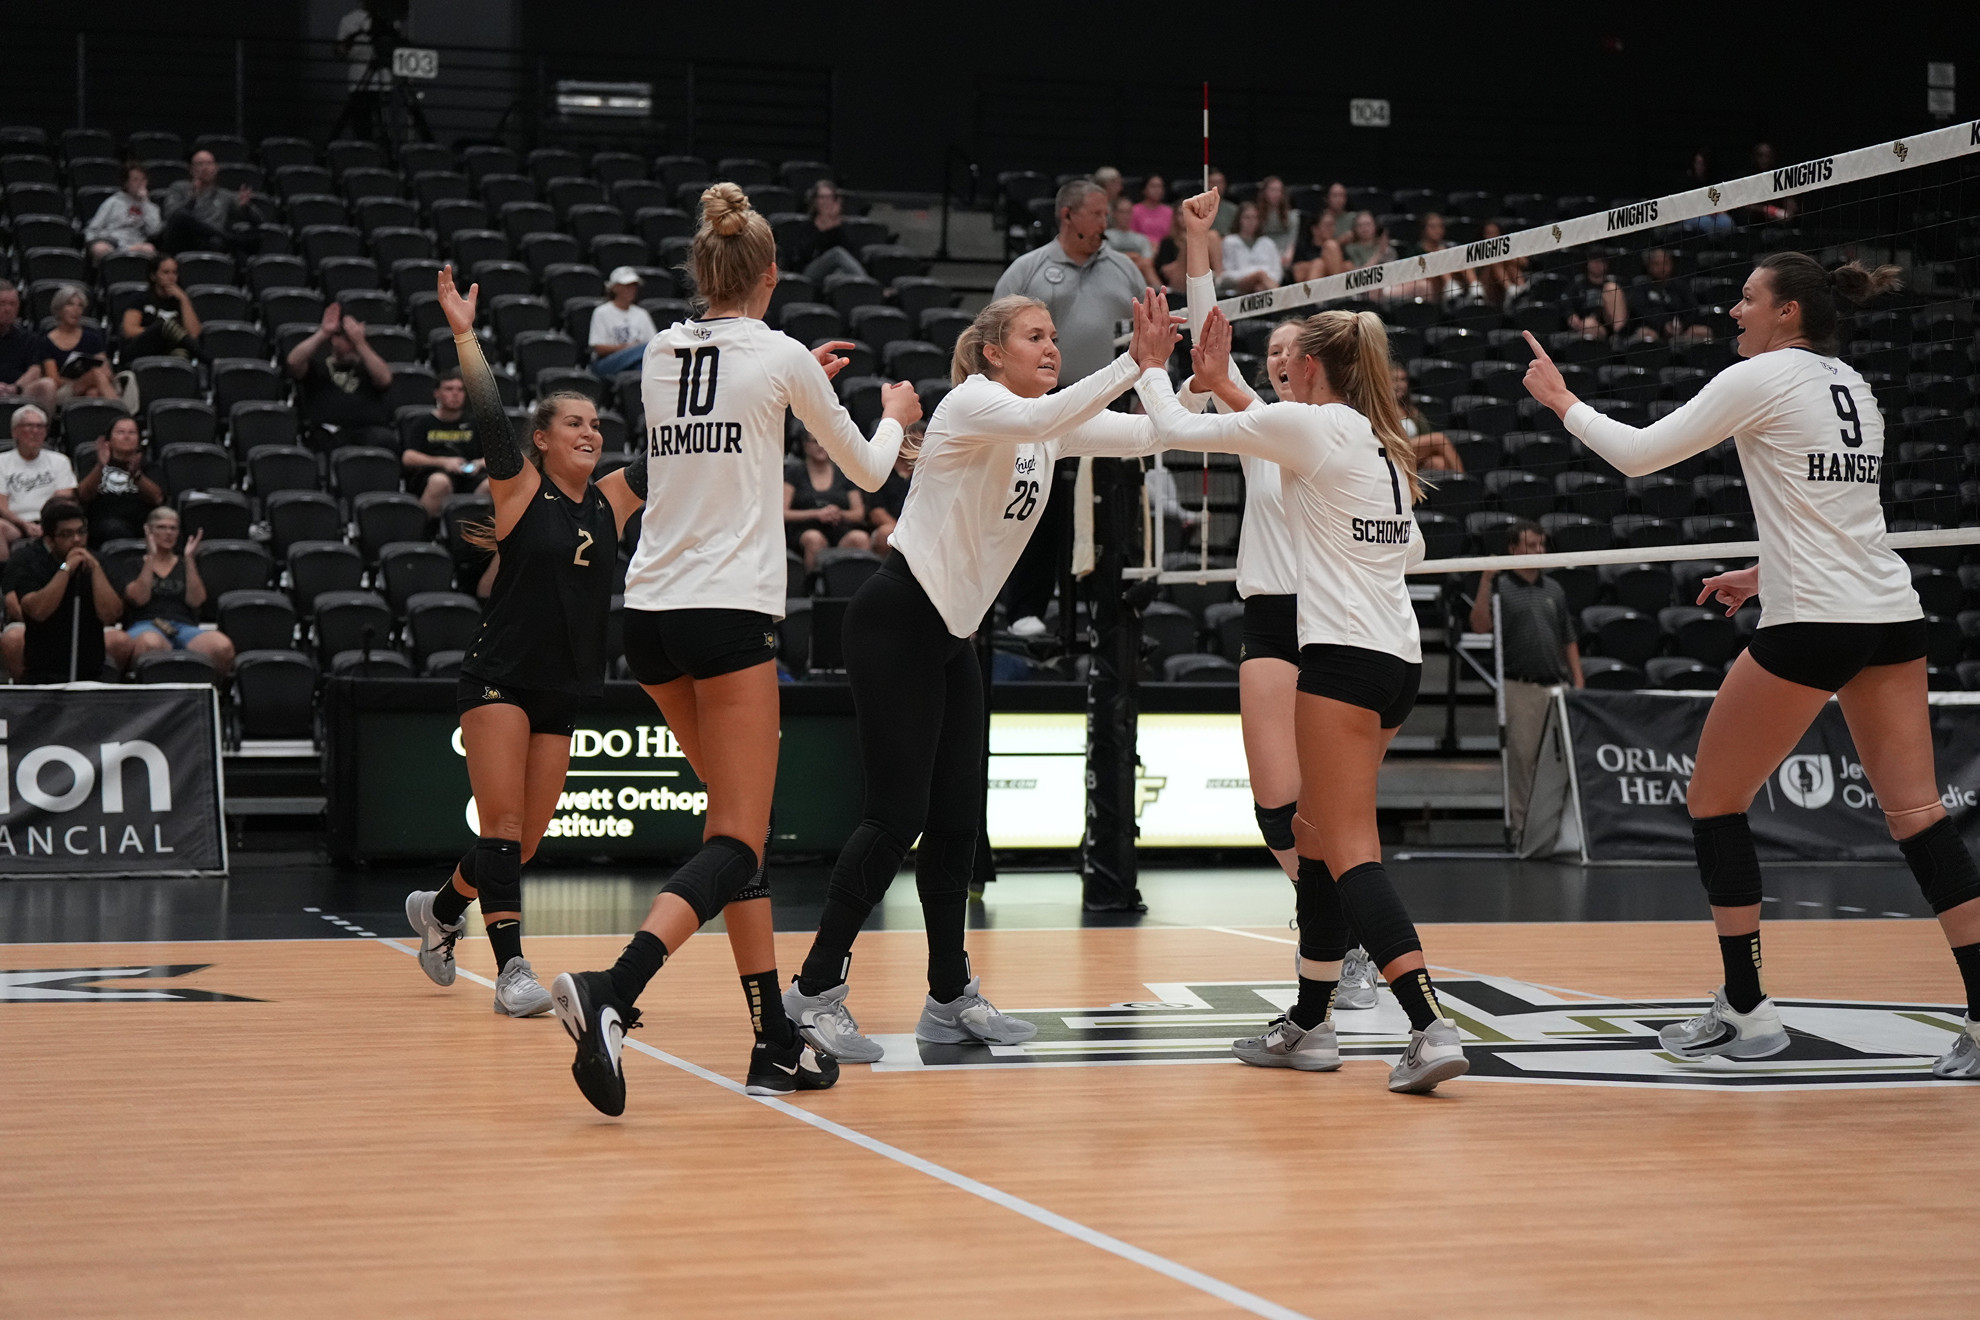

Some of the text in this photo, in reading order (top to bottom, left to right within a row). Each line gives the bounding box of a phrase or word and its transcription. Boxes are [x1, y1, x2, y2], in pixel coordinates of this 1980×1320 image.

[1240, 291, 1273, 313] KNIGHTS
[1346, 266, 1383, 290] KNIGHTS
[1466, 236, 1510, 263] KNIGHTS
[1607, 200, 1658, 231] KNIGHTS
[1773, 158, 1834, 192] KNIGHTS
[674, 346, 720, 418] 10
[1829, 384, 1863, 448] 9
[651, 422, 742, 457] ARMOUR
[1003, 480, 1039, 521] 26
[1378, 447, 1402, 515] 1
[573, 528, 594, 567] 2
[1352, 518, 1411, 544] SCHOME
[555, 787, 708, 815] wett Orthop
[1617, 776, 1687, 805] HEA
[545, 812, 634, 837] stitute
